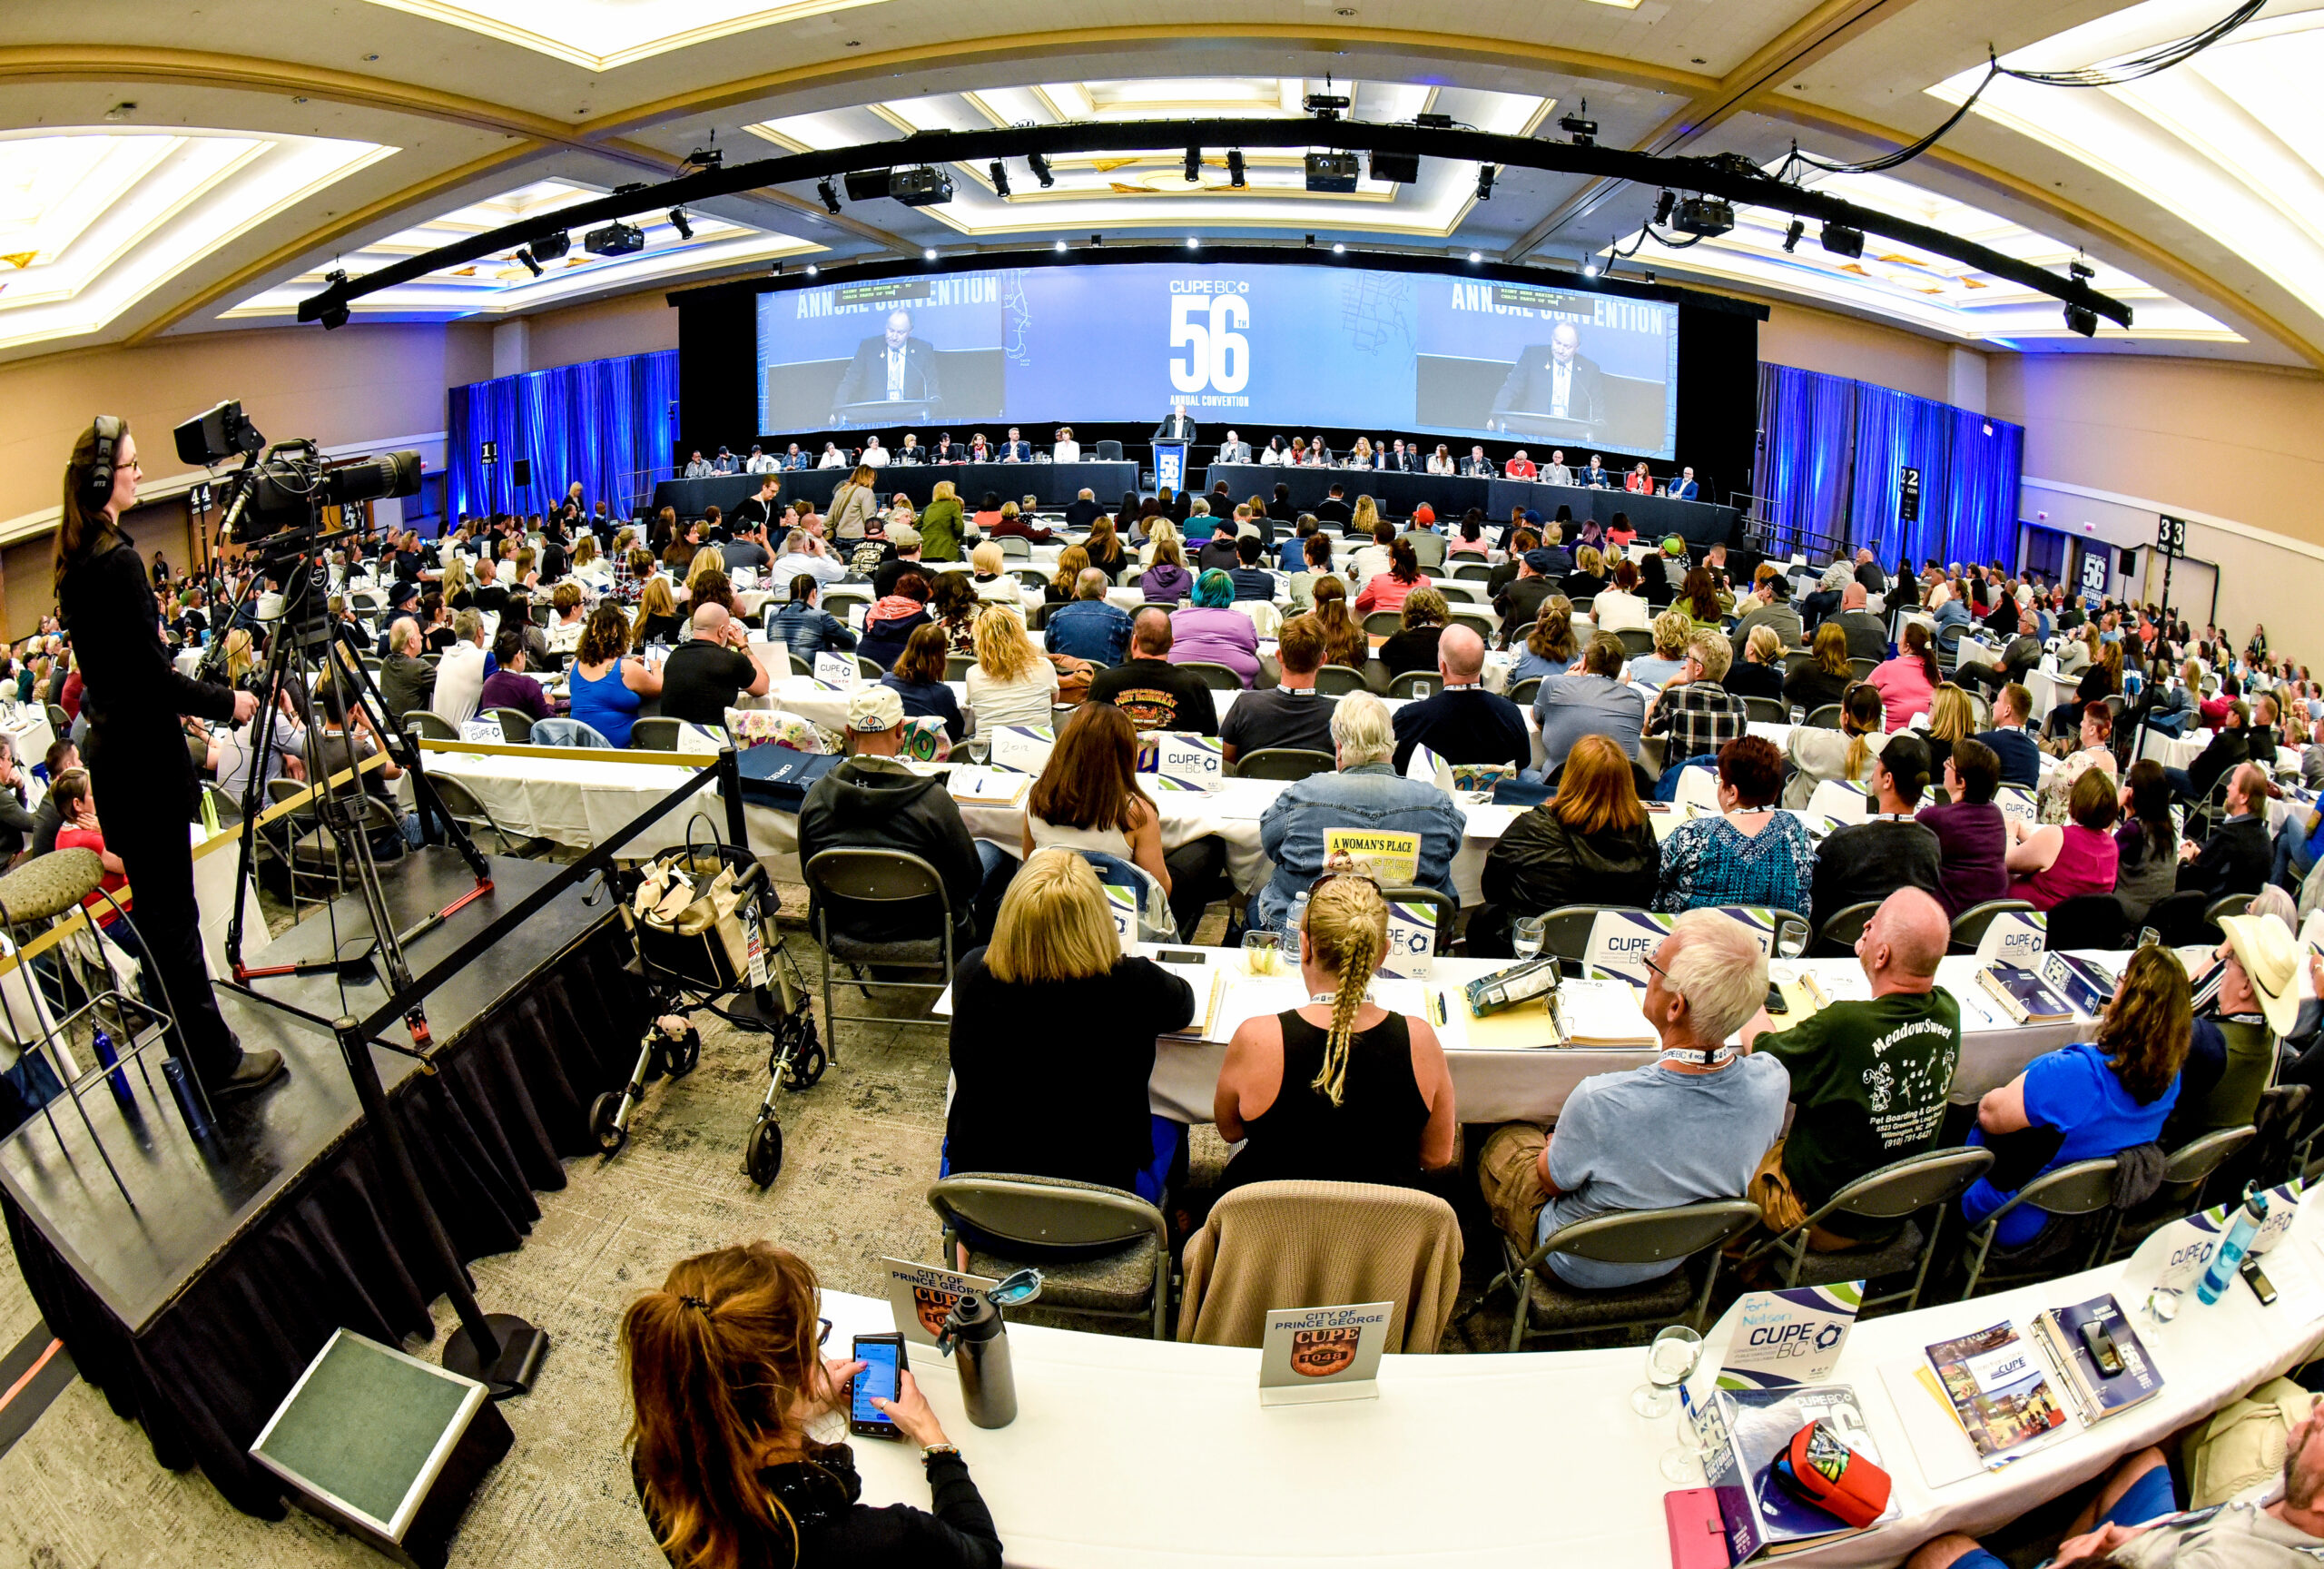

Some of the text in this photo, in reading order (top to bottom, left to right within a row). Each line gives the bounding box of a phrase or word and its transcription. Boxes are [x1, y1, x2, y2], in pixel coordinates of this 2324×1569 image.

[1237, 320, 1247, 328] TH
[1169, 293, 1250, 394] 56
[1169, 395, 1250, 408] ANNUAL CONVENTION
[482, 444, 490, 458] 1
[1907, 469, 1918, 487] 2
[191, 488, 200, 505] 4
[202, 485, 211, 502] 4
[2160, 518, 2171, 541] 3
[2173, 522, 2183, 546] 3
[2158, 543, 2170, 553] PRO
[2171, 548, 2183, 558] PRO
[2083, 557, 2106, 590] 56
[820, 664, 841, 672] CUPE
[1114, 693, 1135, 706] FORT
[471, 727, 490, 741] CUPE
[1168, 753, 1201, 765] CUPE
[1185, 764, 1201, 774] BC
[2005, 803, 2025, 813] CUPE
[1333, 837, 1413, 853] A WOMAN'S PLACE
[1372, 857, 1414, 869] IS IN HER
[1382, 867, 1413, 881] UNION
[1385, 929, 1405, 942] PE
[2005, 933, 2031, 946] CUPE
[1608, 937, 1650, 952] CUPE
[2016, 945, 2030, 957] BC
[1869, 1116, 1884, 1125] Pet
[1886, 1110, 1918, 1124] Boarding
[1918, 1107, 1925, 1116] &
[1915, 1123, 1924, 1131] NC
[1884, 1135, 1904, 1150] (910)
[2171, 1241, 2202, 1266] CUPE
[891, 1271, 937, 1288] PRINCE
[917, 1269, 964, 1286] CITY OF
[914, 1287, 960, 1308] CUP
[1744, 1298, 1772, 1313] Fort
[925, 1313, 946, 1324] 10
[1275, 1314, 1384, 1330] PRINCE GEORGE
[1305, 1309, 1357, 1321] CITY OF
[1742, 1313, 1793, 1327] Nelson
[1295, 1327, 1360, 1344] CUPE
[1749, 1322, 1816, 1346] CUPE
[1302, 1351, 1343, 1363] 1048
[1775, 1340, 1808, 1359] BC
[1998, 1357, 2026, 1374] CUPE
[1705, 1446, 1734, 1478] VICTORIA
